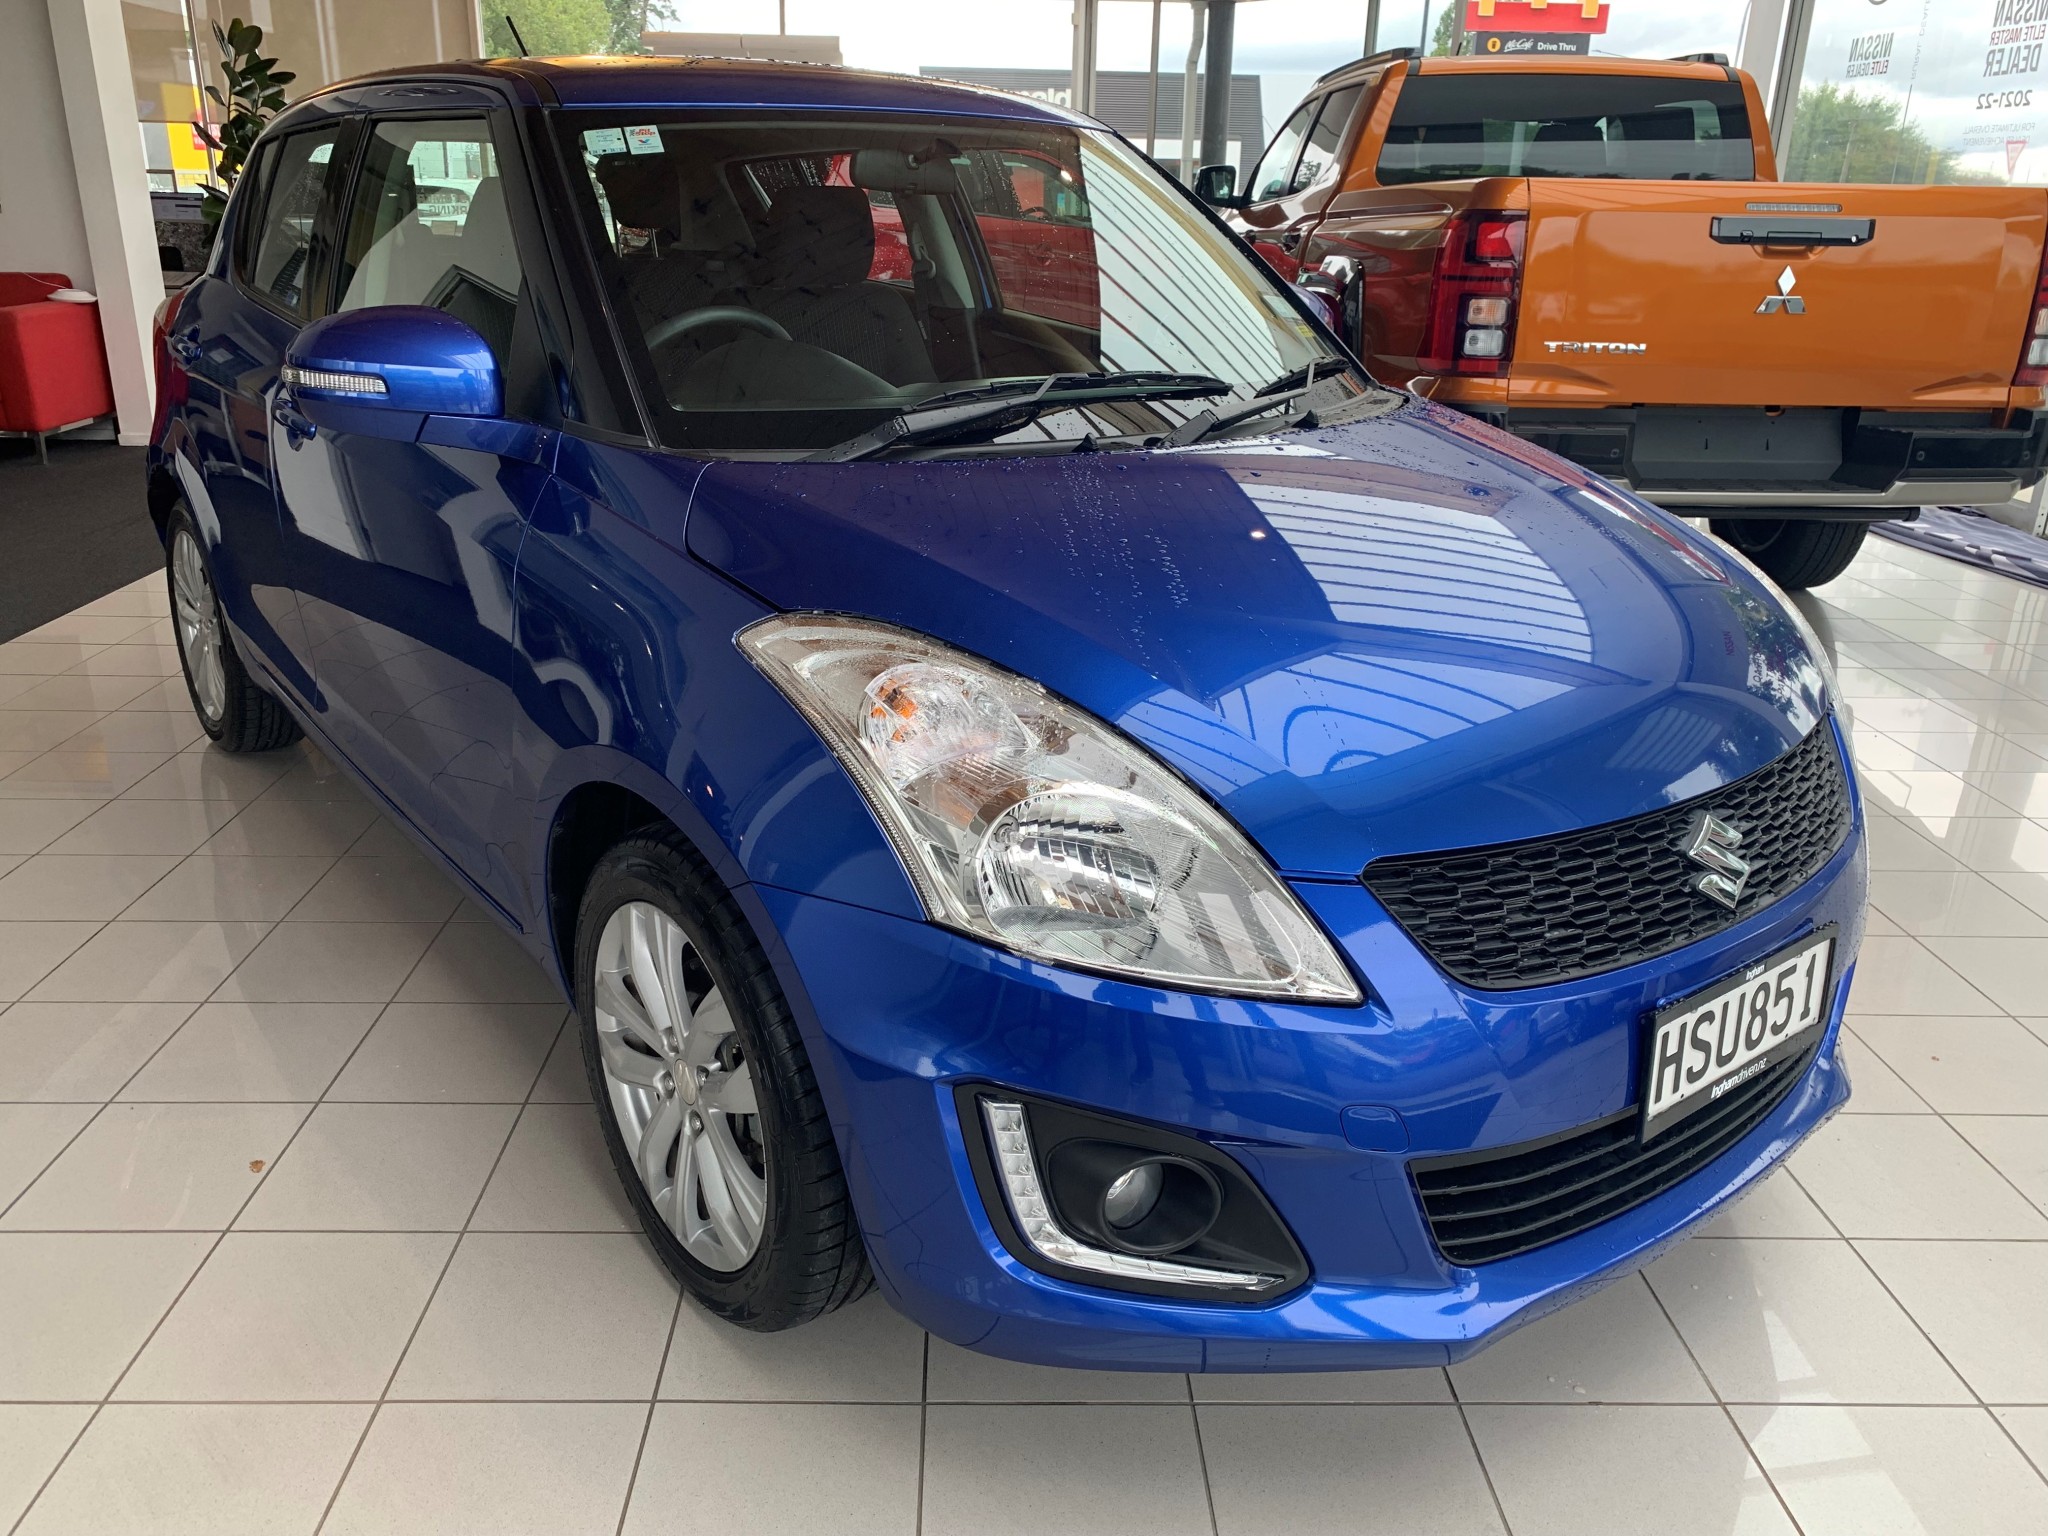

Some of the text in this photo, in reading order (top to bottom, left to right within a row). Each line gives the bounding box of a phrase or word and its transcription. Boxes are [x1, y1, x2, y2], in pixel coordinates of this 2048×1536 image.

[1537, 42, 1557, 51] Drive
[1558, 42, 1577, 51] Thru
[1544, 341, 1647, 354] TRITON
[1746, 964, 1765, 980] Ingham
[1654, 953, 1818, 1105] HSU851
